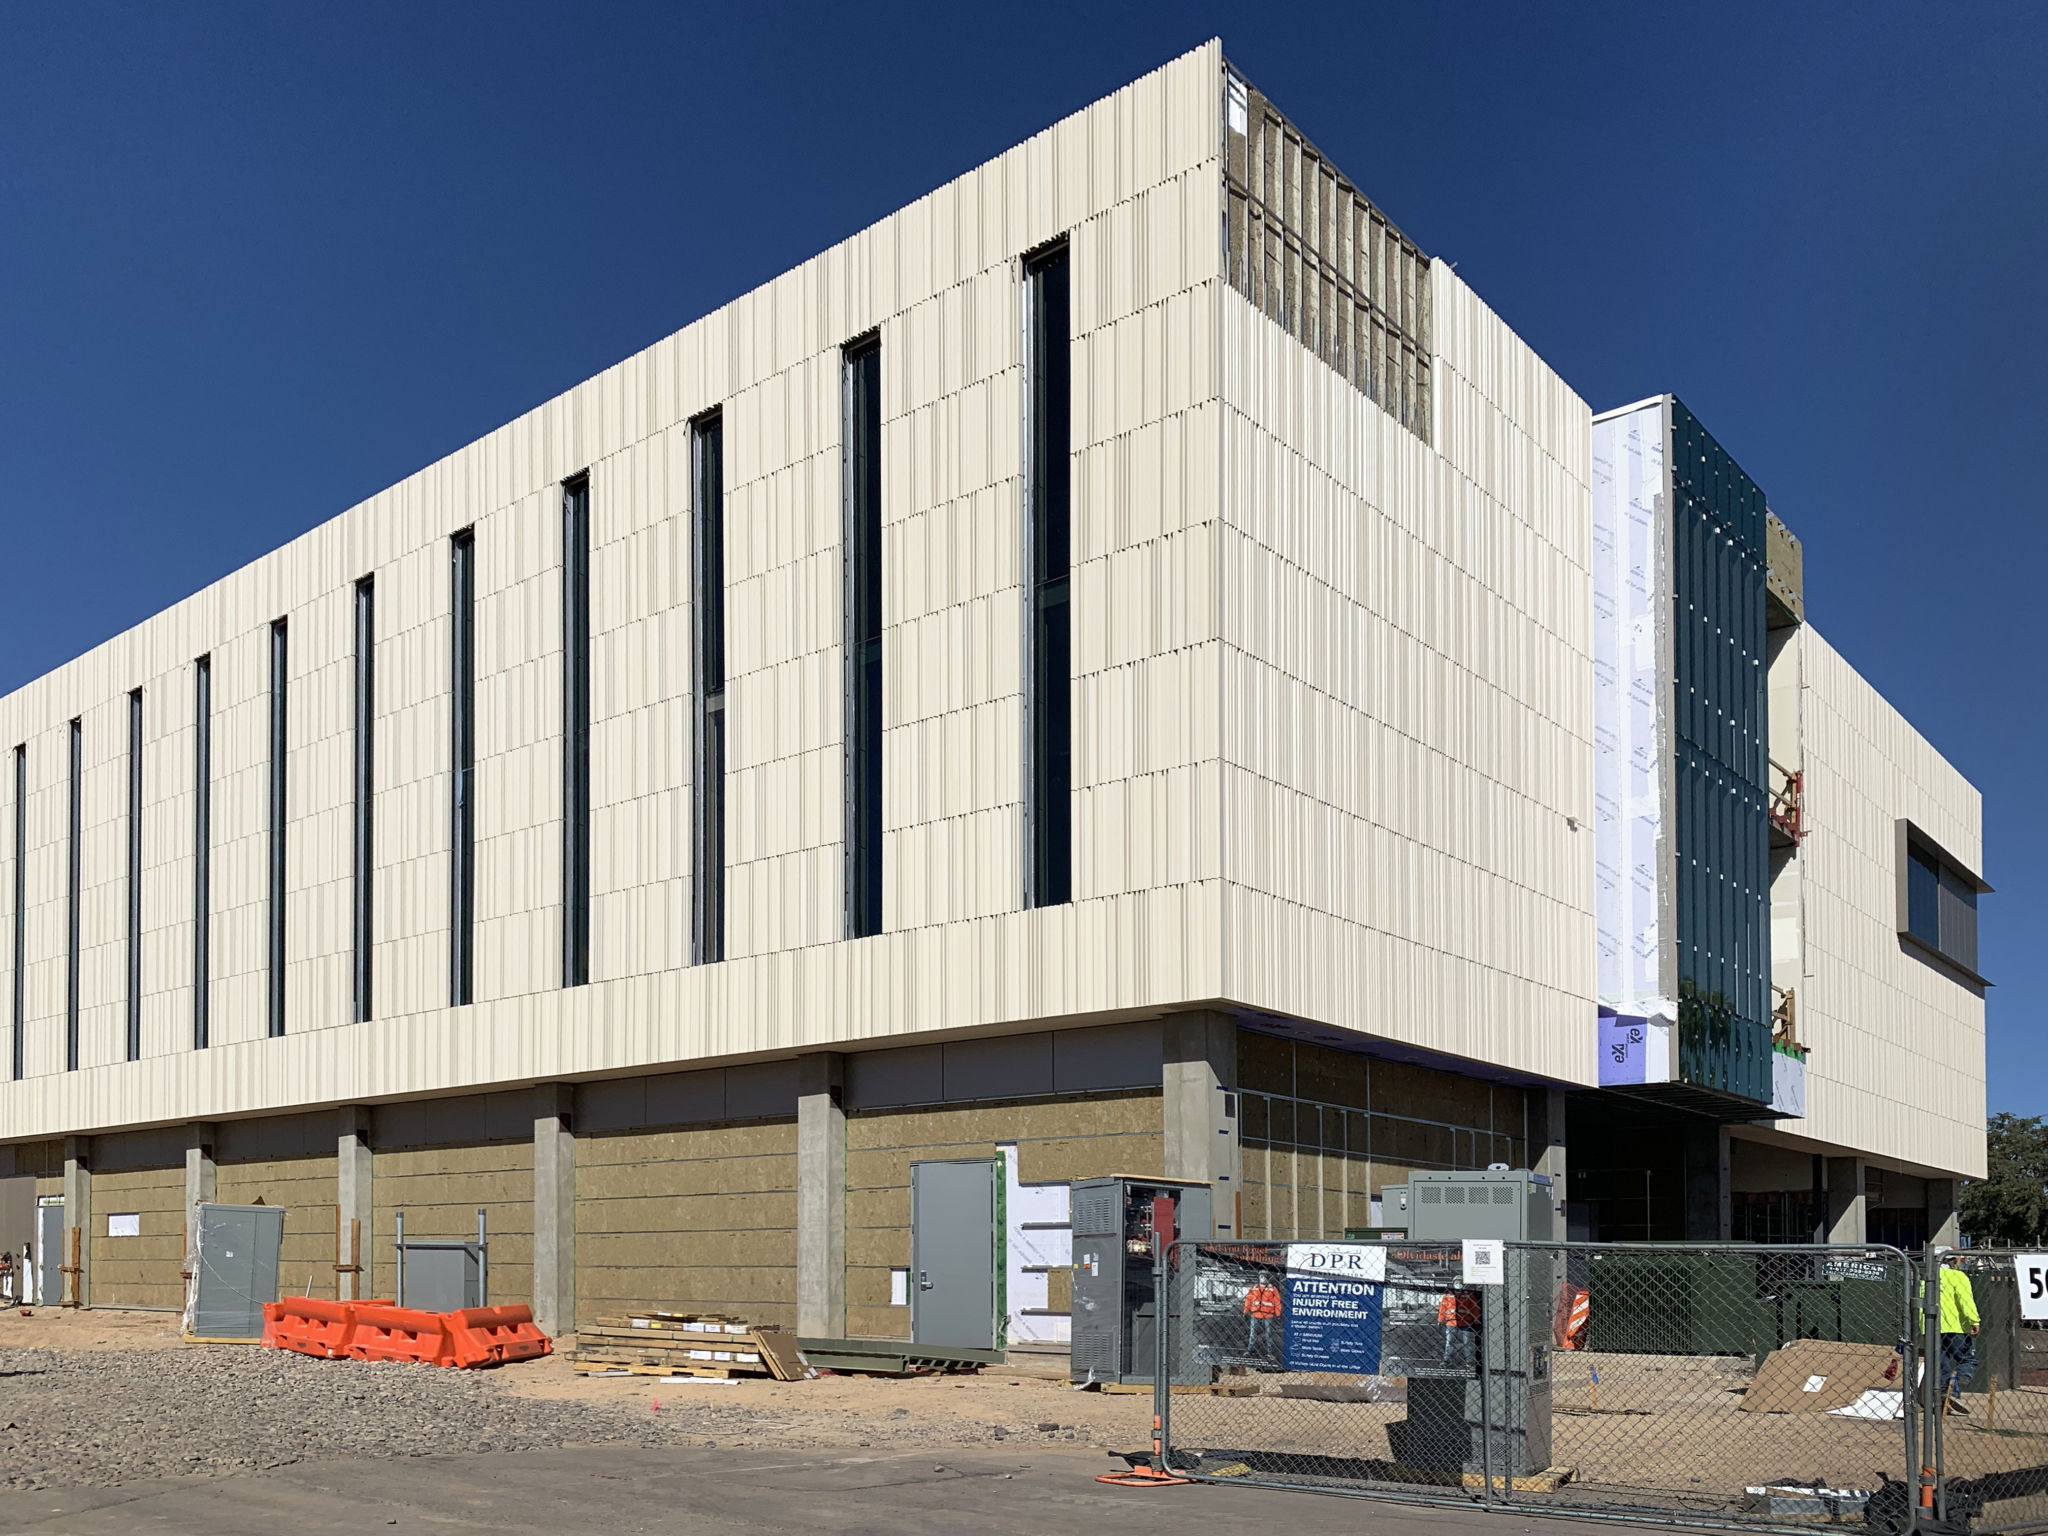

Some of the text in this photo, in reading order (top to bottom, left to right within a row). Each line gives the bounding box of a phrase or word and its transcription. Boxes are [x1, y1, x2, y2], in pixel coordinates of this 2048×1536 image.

[1309, 1252, 1363, 1270] DPR
[1826, 1261, 1884, 1272] AMERICAN
[1293, 1281, 1375, 1296] ATTENTION
[2029, 1267, 2048, 1299] 5
[1292, 1298, 1359, 1309] INJURY FREE
[1292, 1307, 1368, 1320] ENVIRONMENT
